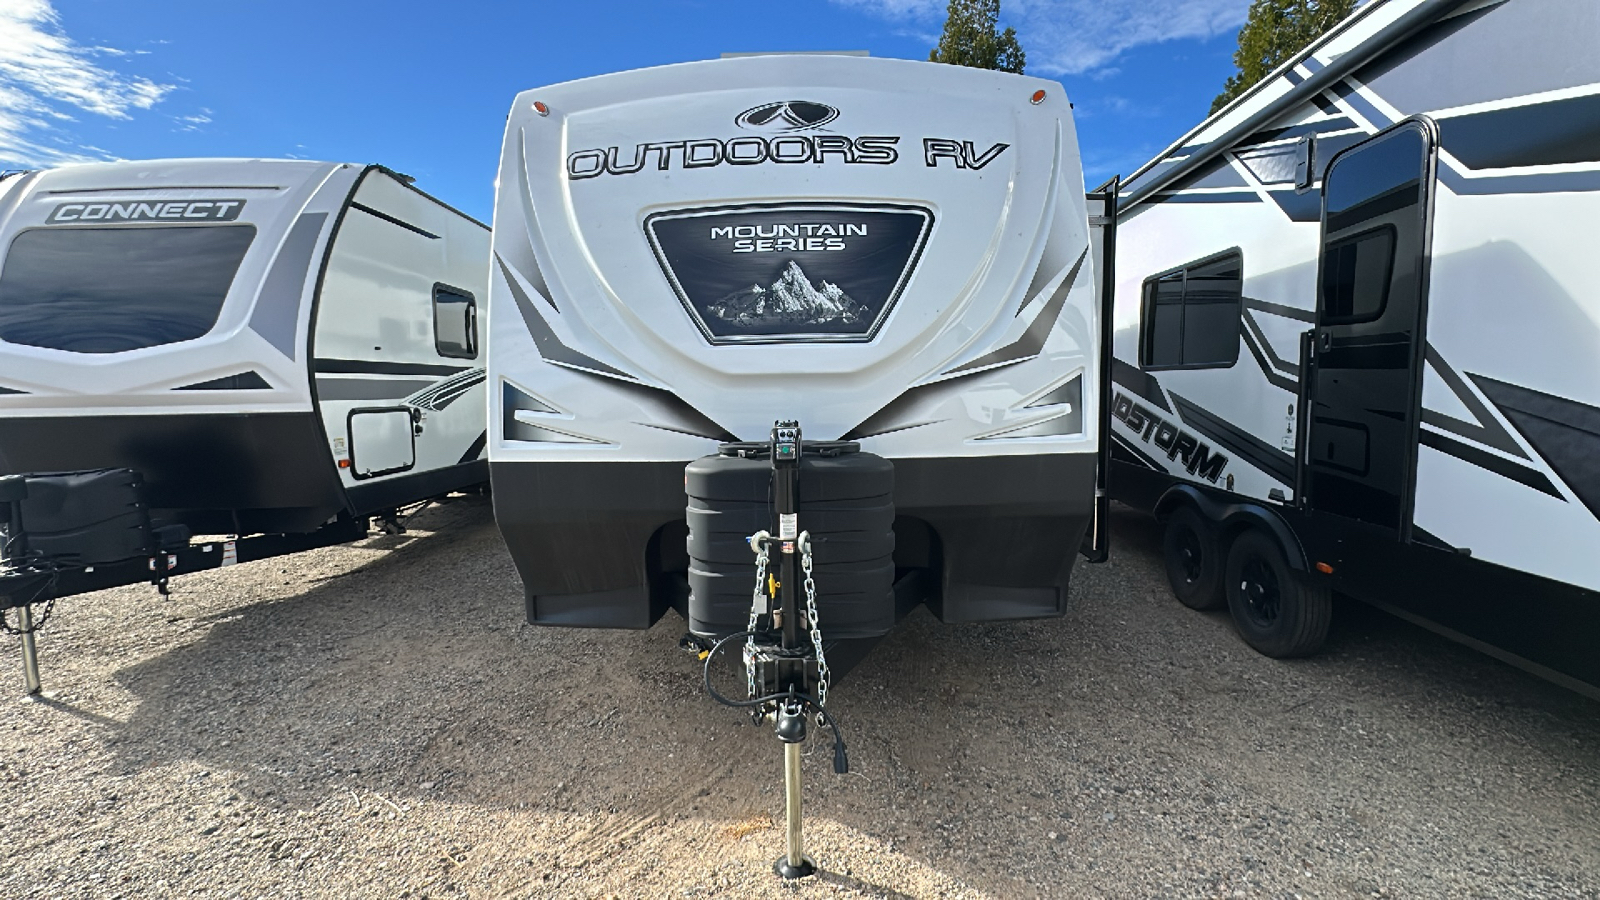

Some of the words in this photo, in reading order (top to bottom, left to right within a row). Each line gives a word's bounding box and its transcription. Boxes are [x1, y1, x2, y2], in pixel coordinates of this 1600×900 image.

[566, 135, 901, 182] OUTDOORS
[923, 137, 1011, 172] RV
[53, 201, 239, 221] CONNECT
[710, 223, 868, 240] MOUNTAIN
[733, 237, 847, 253] SERIES
